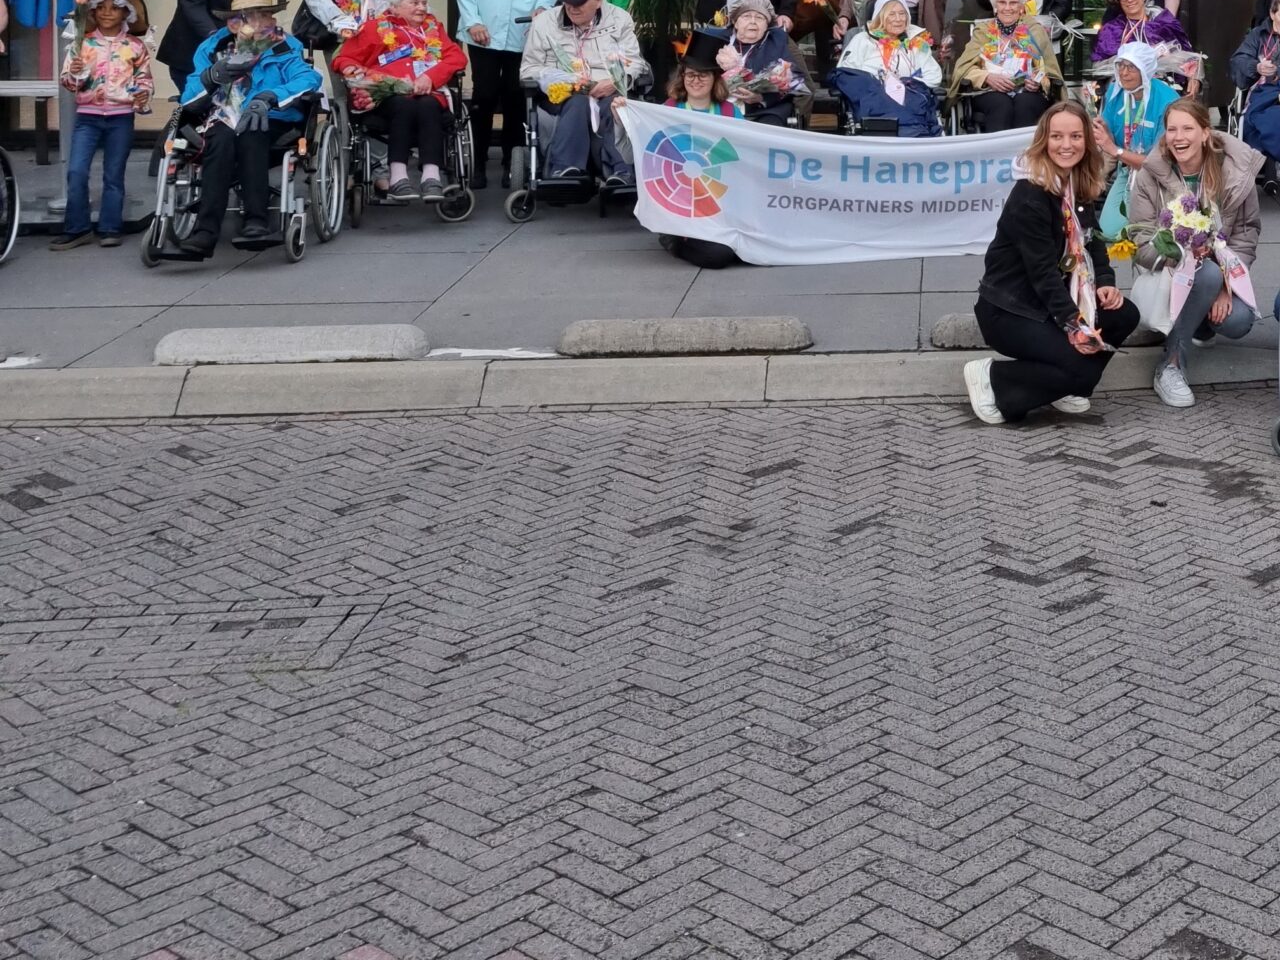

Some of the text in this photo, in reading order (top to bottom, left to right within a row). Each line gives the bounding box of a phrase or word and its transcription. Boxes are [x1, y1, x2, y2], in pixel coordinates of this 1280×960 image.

[767, 147, 1013, 194] De Hanepra
[767, 194, 1007, 214] ZORGPARTNERS MIDDEN-
